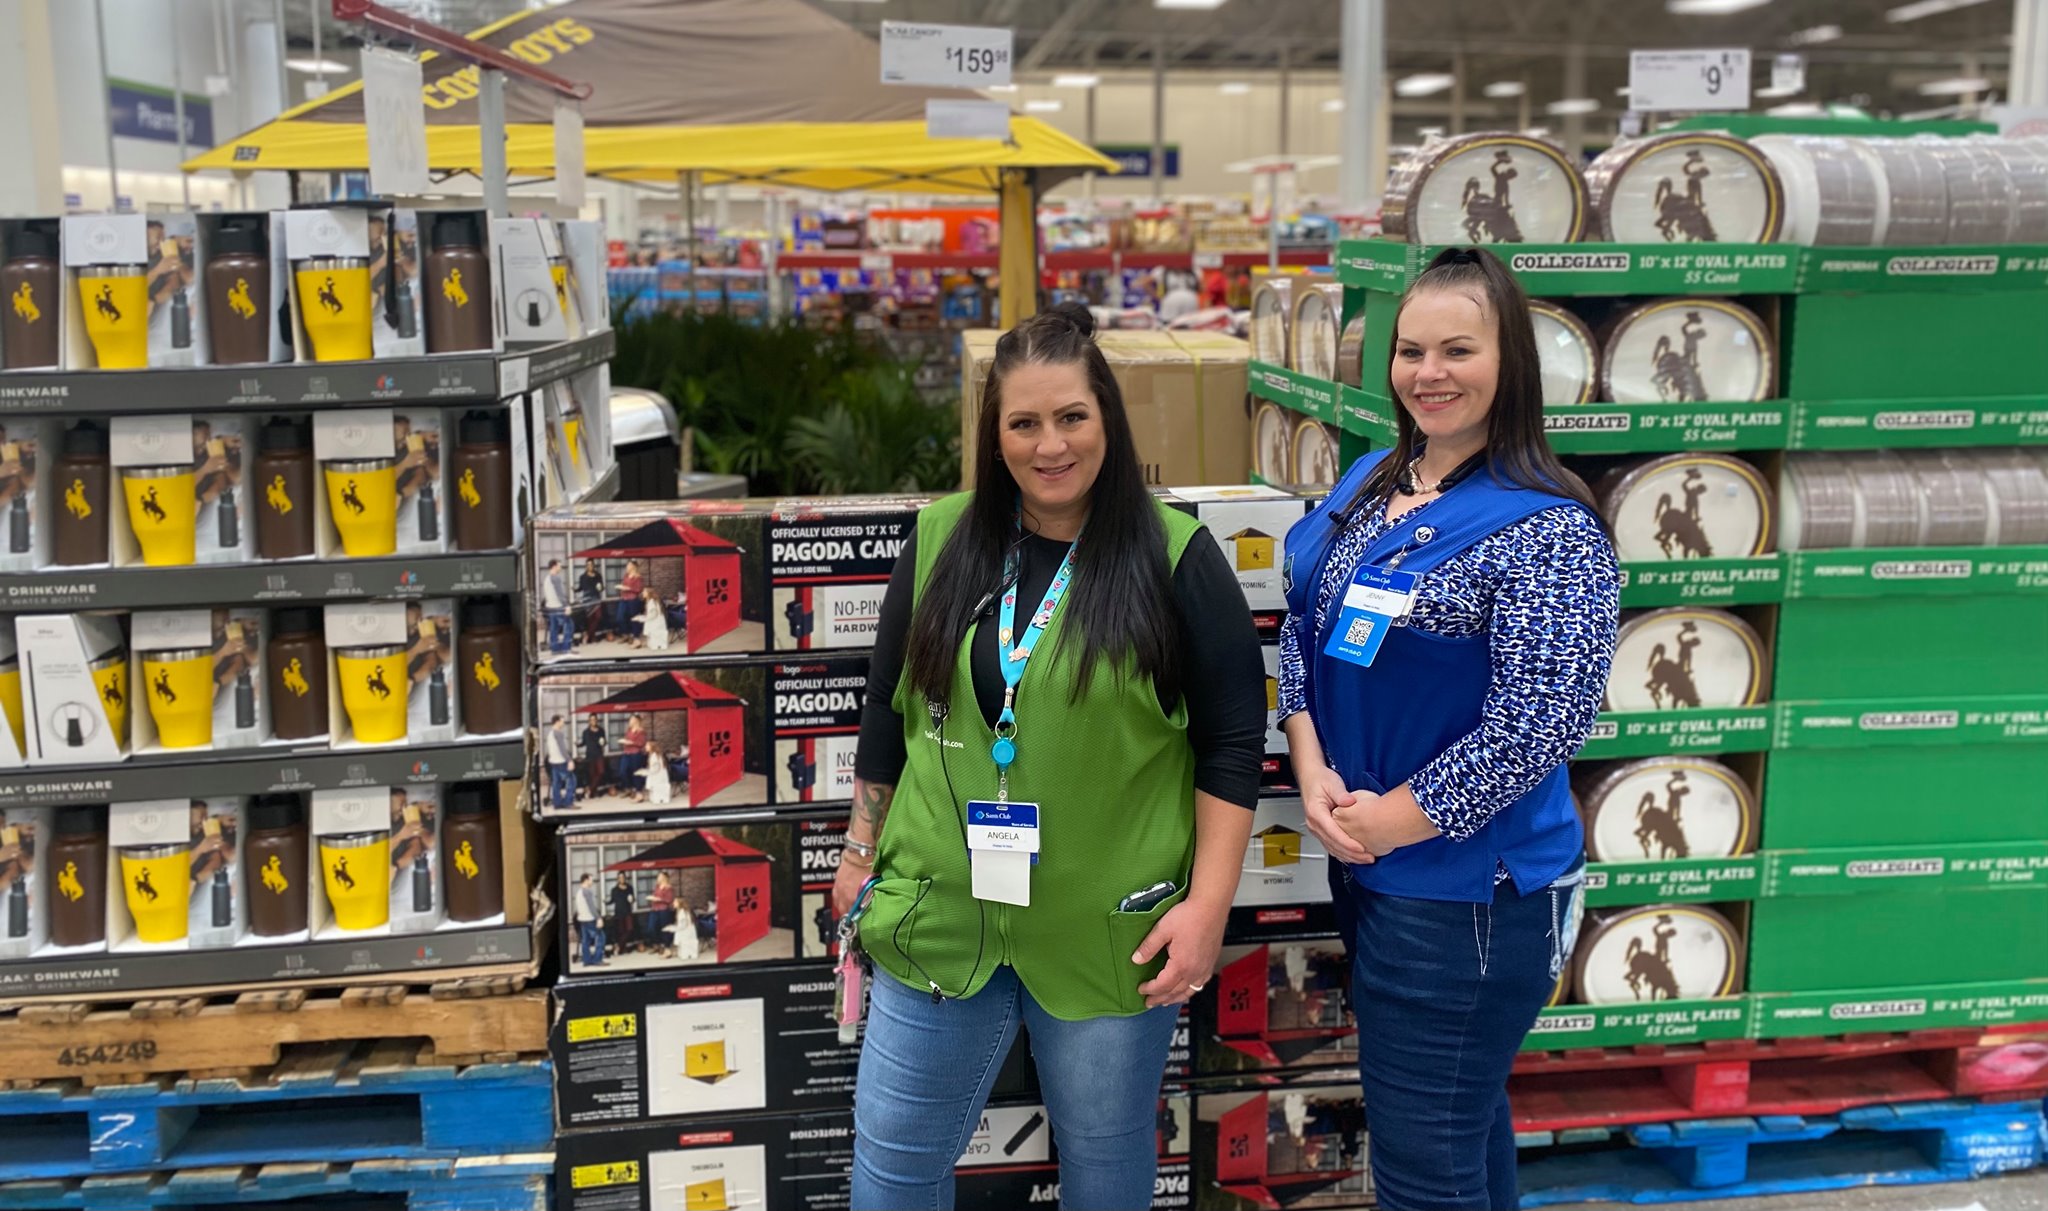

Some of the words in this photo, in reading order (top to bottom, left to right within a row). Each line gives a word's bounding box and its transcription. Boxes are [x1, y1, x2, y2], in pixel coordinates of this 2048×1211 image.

[422, 17, 595, 110] COWOYS
[1513, 254, 1628, 270] COLLEGIATE
[1695, 256, 1730, 268] OVAL
[1735, 255, 1787, 268] PLATES
[1684, 272, 1701, 284] 55
[1704, 271, 1740, 284] Count
[0, 386, 69, 398] INKWARE
[1543, 415, 1628, 430] LLEGIATE
[1694, 414, 1729, 427] OVAL
[1732, 413, 1781, 426] PLATES
[1683, 429, 1699, 441] 55
[1703, 429, 1736, 441] Count
[772, 527, 820, 539] OFFICIALLY
[822, 526, 863, 537] LICENSED
[880, 525, 887, 535] X
[772, 541, 855, 562] PAGODA
[859, 539, 907, 560] CAN
[787, 566, 802, 574] TEAM
[817, 565, 832, 573] WALL
[1692, 570, 1726, 583] OVAL
[1729, 569, 1779, 581] PLATES
[8, 584, 96, 596] DRINKWARE
[1366, 592, 1387, 600] JENNY
[1700, 584, 1735, 596] Count
[834, 623, 879, 634] HARDW
[775, 679, 823, 691] OFFICIALLY
[825, 677, 866, 688] LICENSED
[775, 692, 858, 714] PAGODA
[790, 718, 805, 726] TEAM
[820, 716, 834, 724] WALL
[1680, 720, 1714, 733] OVAL
[1717, 718, 1766, 731] PLATES
[1688, 734, 1722, 746] Count
[25, 780, 113, 794] DRINKWARE
[987, 831, 1020, 841] ANGELA
[801, 849, 841, 869] PAG
[1669, 870, 1704, 883] OVAL
[1706, 867, 1755, 881] PLATES
[1677, 883, 1711, 896] Count
[34, 968, 120, 982] DRINKWARE
[789, 982, 836, 993] OTECTION
[2010, 996, 2048, 1007] PLATE
[1534, 1016, 1593, 1029] EGIATE
[1655, 1012, 1690, 1024] OVAL
[1692, 1009, 1741, 1022] PLATES
[1663, 1024, 1698, 1036] Count
[57, 1039, 157, 1067] 454249
[790, 1128, 848, 1140] PROTECTION
[1154, 1175, 1190, 1194] PAG
[1029, 1184, 1061, 1203] OPY
